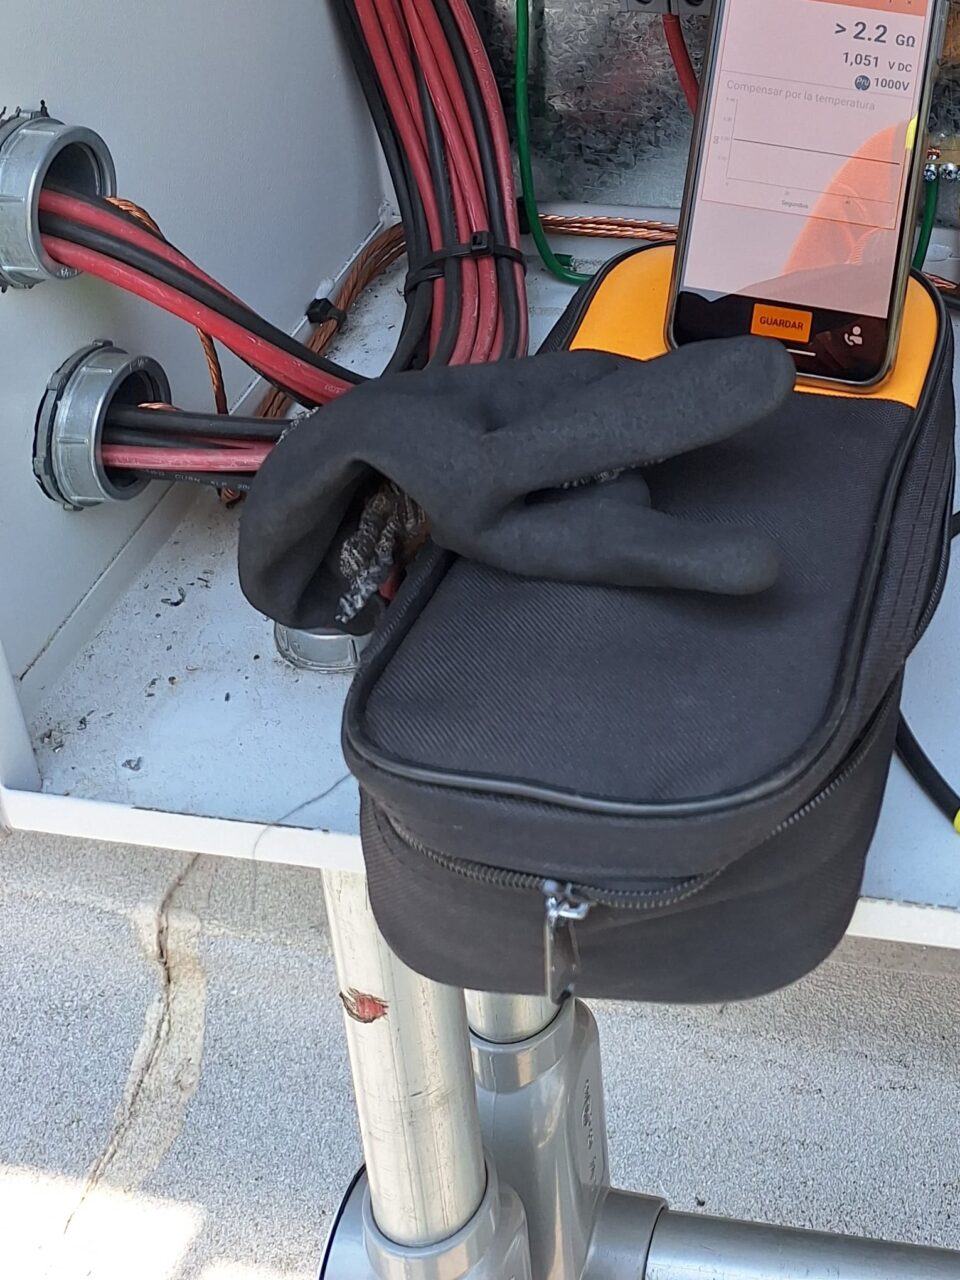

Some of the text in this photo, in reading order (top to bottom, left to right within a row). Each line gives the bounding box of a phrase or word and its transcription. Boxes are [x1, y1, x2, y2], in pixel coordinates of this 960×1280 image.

[853, 21, 888, 43] 2.2
[895, 34, 916, 48] GΩ
[843, 52, 912, 73] 1,051 V DC
[874, 77, 910, 91] 1000V
[726, 79, 876, 111] Compensar por la temperatura
[759, 316, 804, 331] GUARDAR
